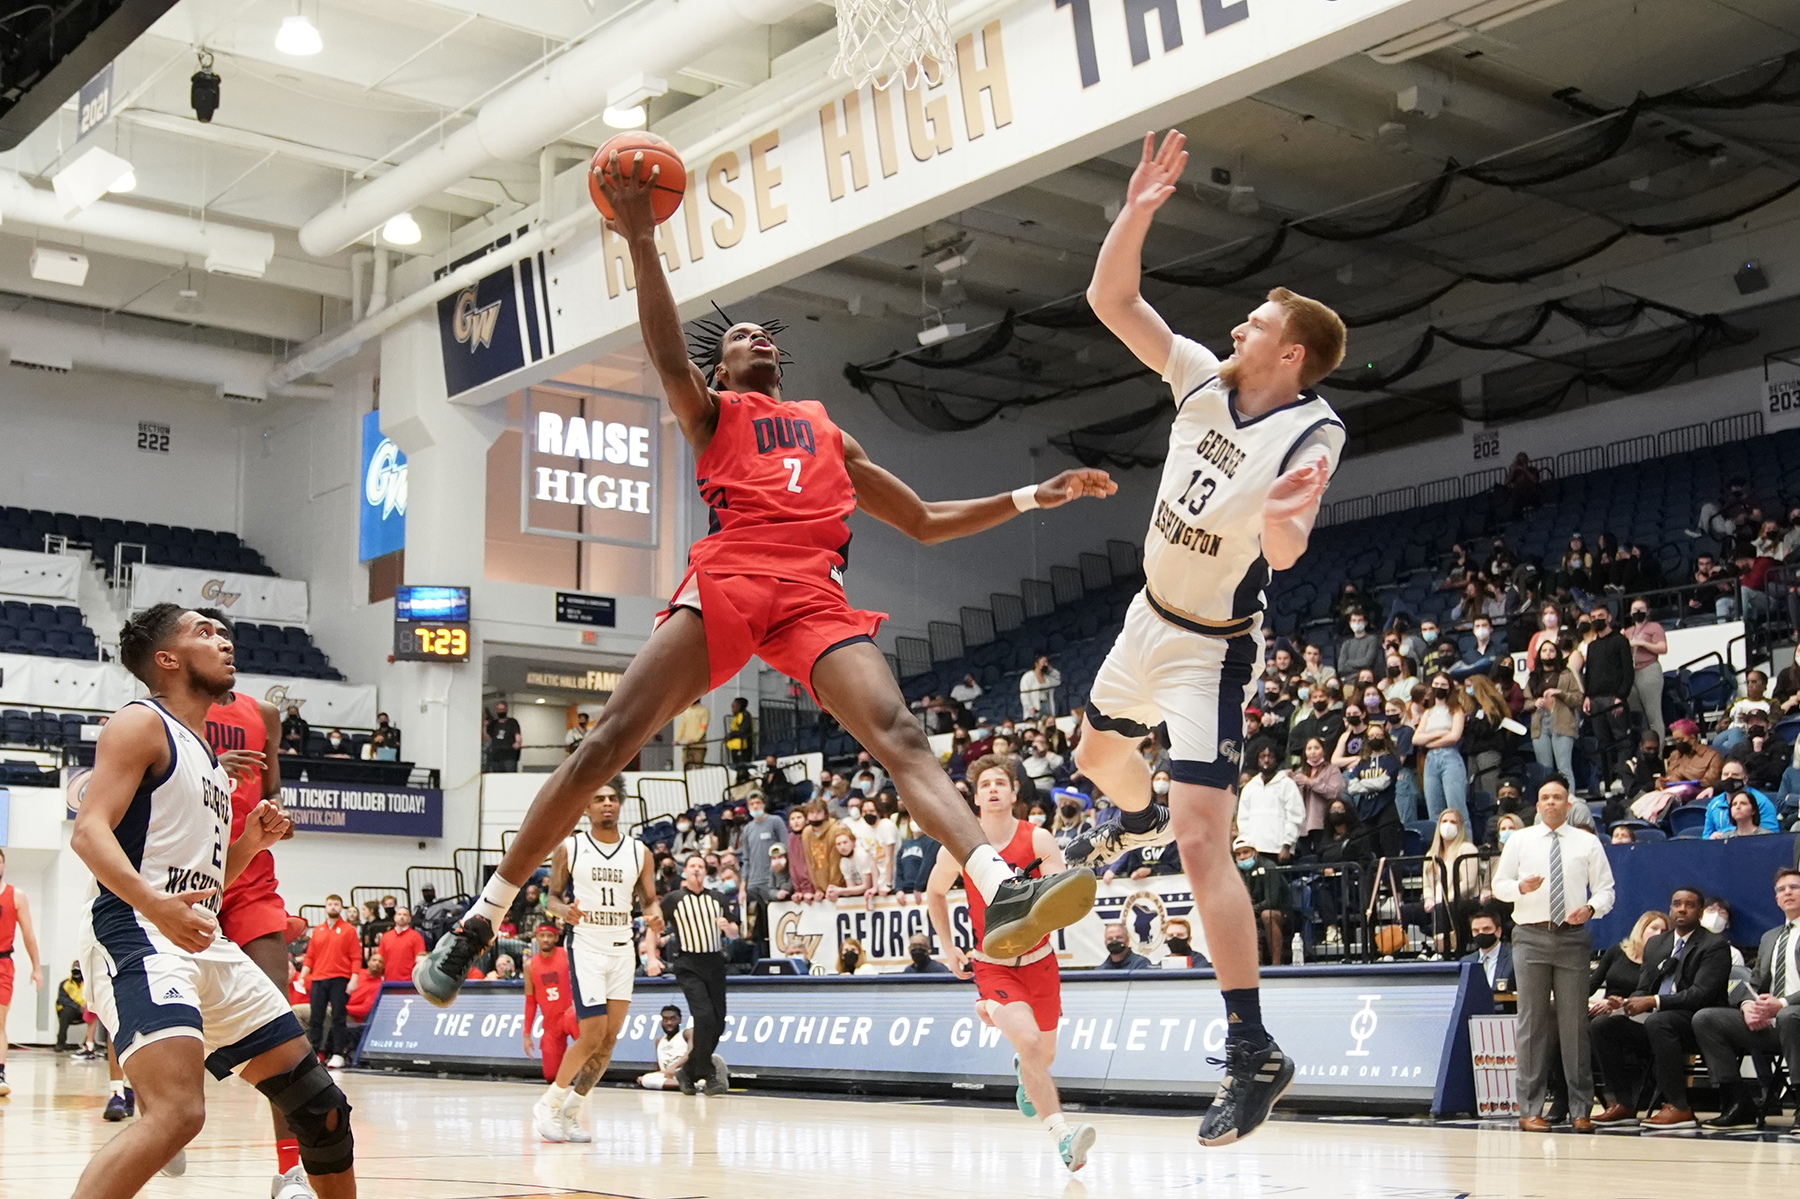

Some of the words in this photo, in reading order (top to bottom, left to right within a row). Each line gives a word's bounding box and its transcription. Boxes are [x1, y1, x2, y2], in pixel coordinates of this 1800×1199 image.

[81, 87, 109, 134] 2021
[820, 19, 1012, 202] HIGH
[1770, 390, 1800, 412] 203
[138, 432, 169, 451] 222
[538, 411, 650, 468] RAISE
[1473, 440, 1499, 459] 202
[783, 458, 802, 494] 2
[536, 467, 651, 514] HIGH
[1178, 470, 1216, 515] 13
[1155, 499, 1223, 557] SHINGTON
[414, 628, 468, 656] 7:23
[299, 788, 340, 809] TICKET
[341, 791, 386, 813] HOLDER
[387, 793, 425, 814] TODAY!
[212, 825, 222, 869] 2
[1141, 847, 1165, 861] GW
[592, 867, 624, 883] GEORGE
[601, 887, 615, 907] 11
[546, 987, 560, 1001] 35
[434, 1013, 474, 1037] THE
[719, 1015, 872, 1045] CLOTHIER
[889, 1017, 934, 1046] OF
[1057, 1018, 1229, 1051] THLETIC
[1295, 1064, 1349, 1076] AILOR
[1359, 1066, 1380, 1077] ON
[1391, 1066, 1422, 1078] TAP
